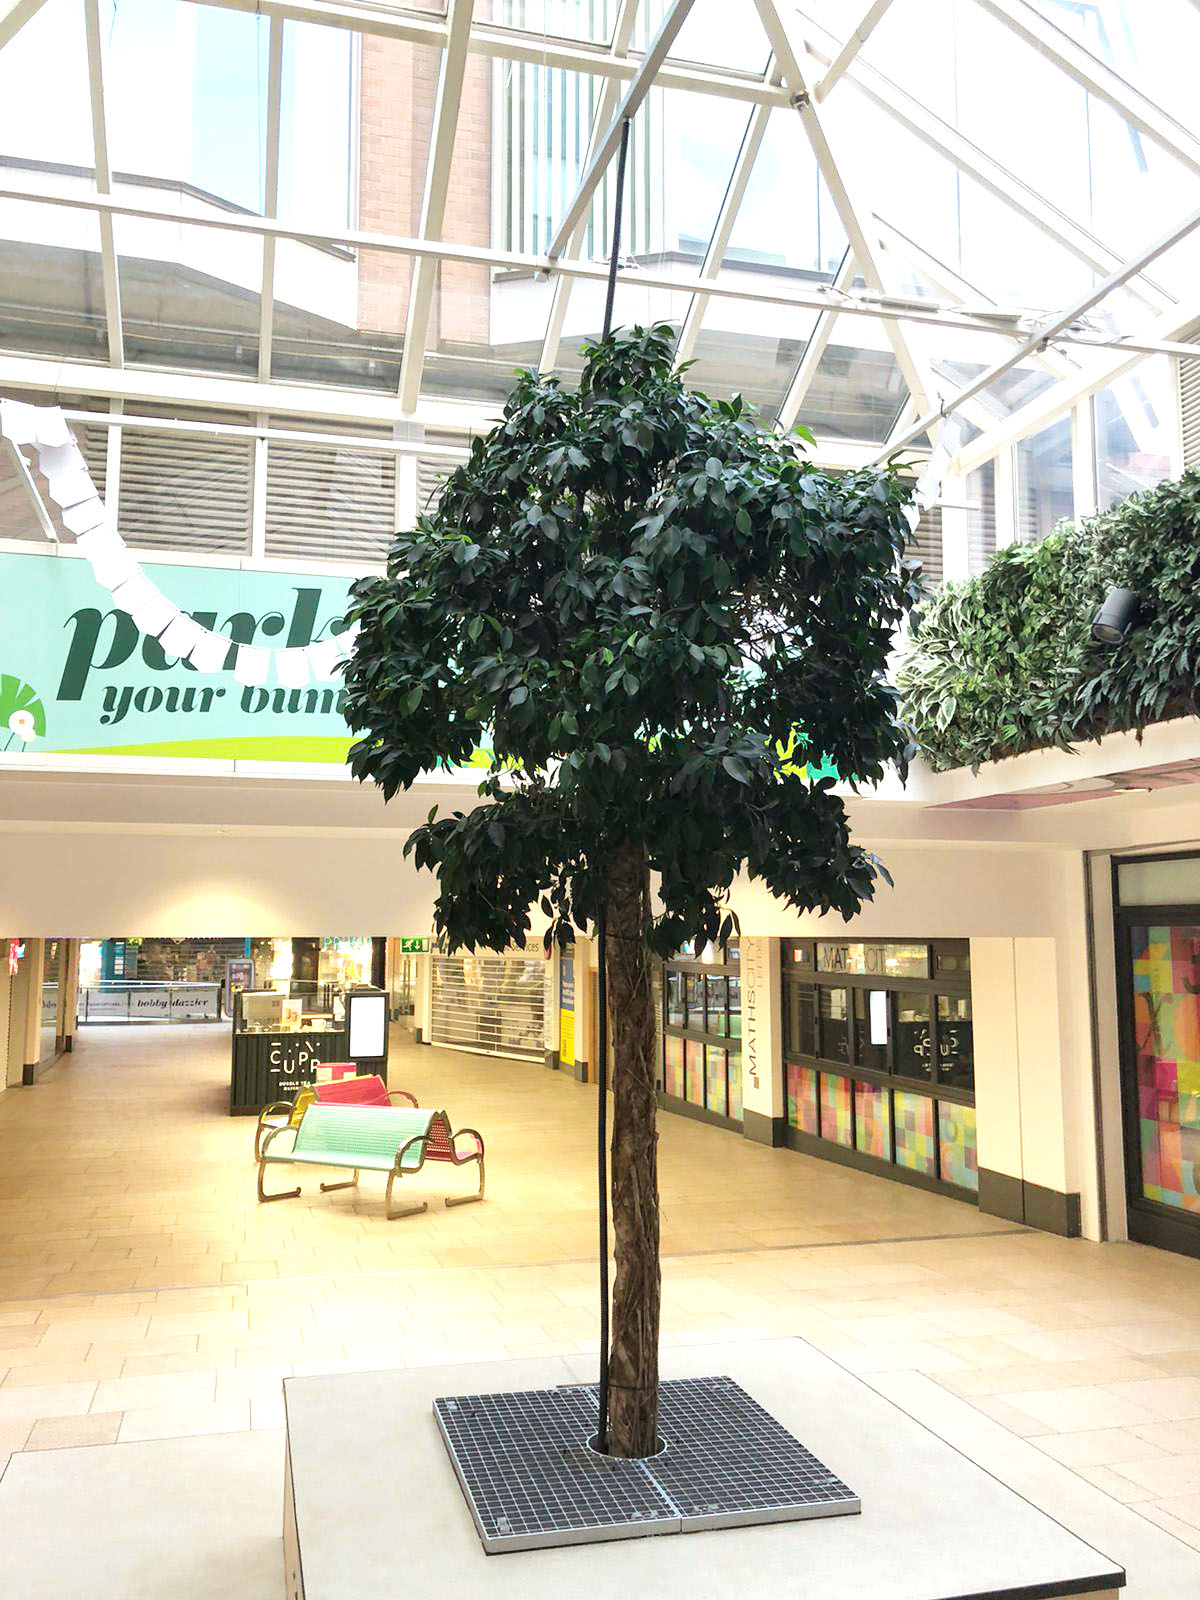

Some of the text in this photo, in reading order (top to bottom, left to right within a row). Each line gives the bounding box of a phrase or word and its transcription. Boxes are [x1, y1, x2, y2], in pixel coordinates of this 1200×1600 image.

[99, 685, 226, 726] your
[137, 999, 168, 1010] bobby
[172, 998, 209, 1008] dazzler
[747, 936, 757, 1076] MATHSCITY
